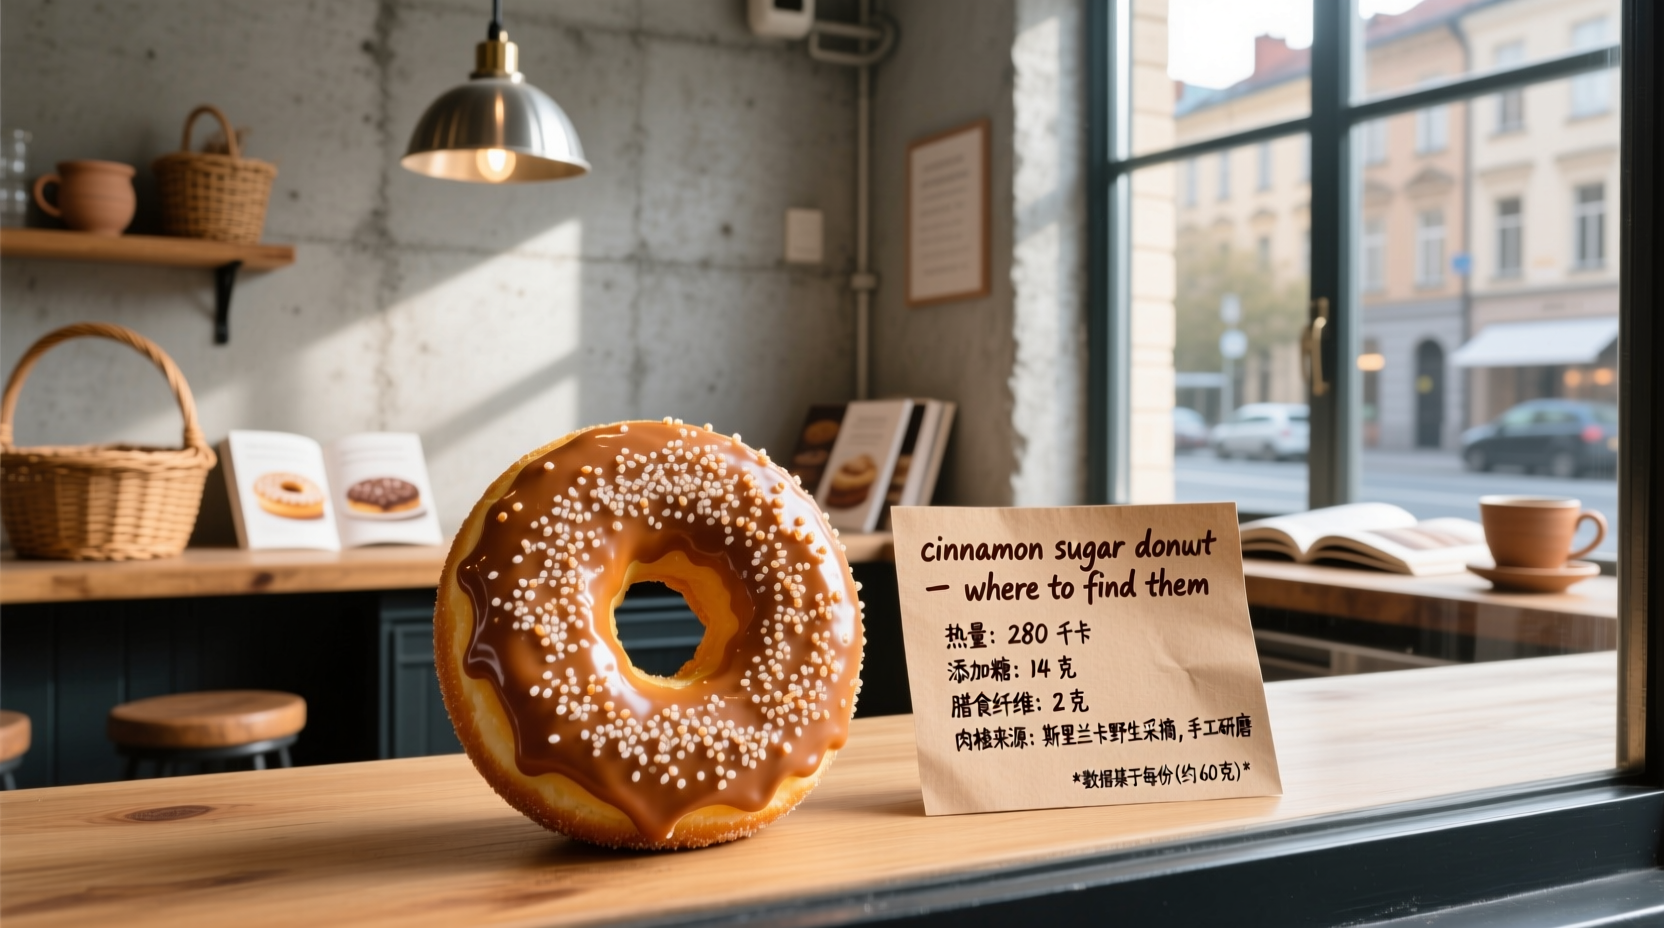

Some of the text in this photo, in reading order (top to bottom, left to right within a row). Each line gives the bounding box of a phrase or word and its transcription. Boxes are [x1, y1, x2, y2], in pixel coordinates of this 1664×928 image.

[920, 535, 1044, 562] cinnamon
[1054, 539, 1127, 573] sugar
[964, 571, 1040, 602] where
[1047, 574, 1075, 600] to
[1082, 569, 1137, 606] find
[1144, 567, 1210, 598] them
[1007, 621, 1048, 645] 280
[1056, 619, 1092, 646] 千卡
[1030, 658, 1051, 679] 14
[1057, 654, 1077, 680] 克
